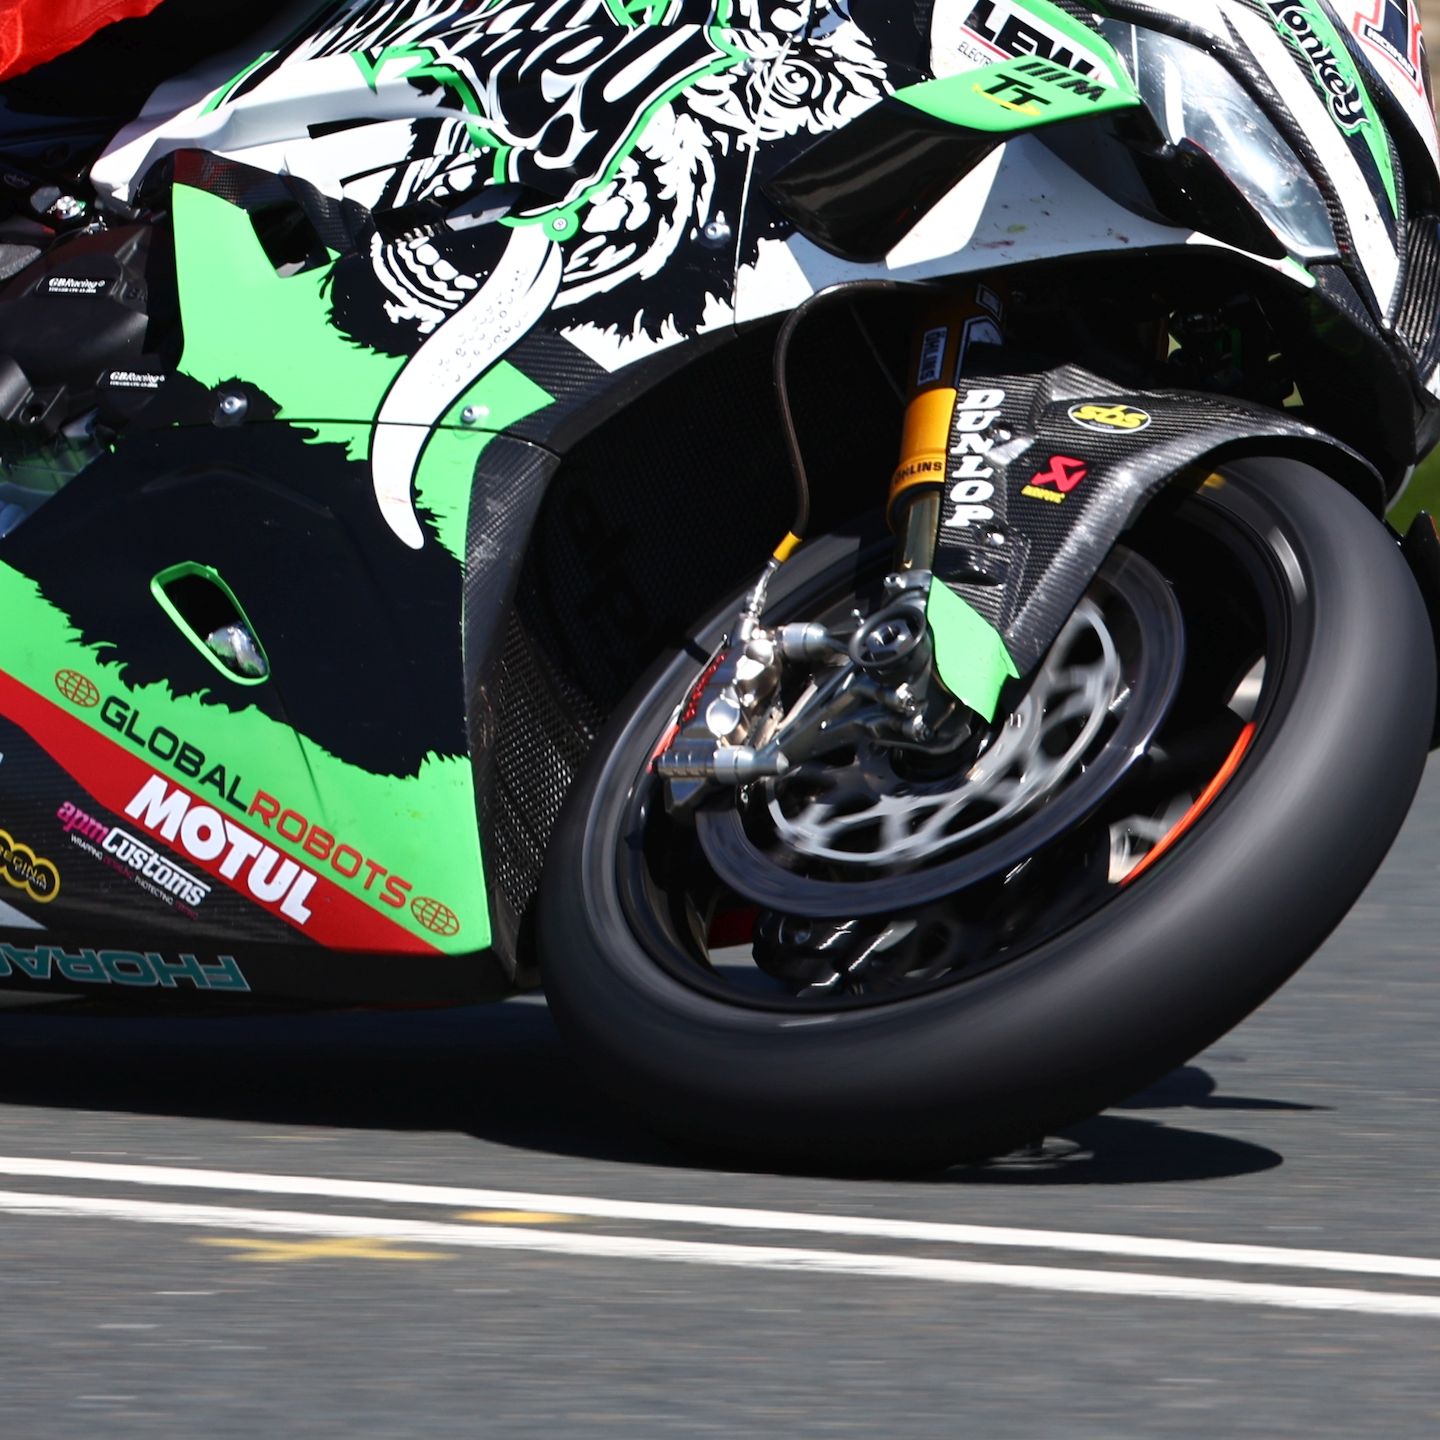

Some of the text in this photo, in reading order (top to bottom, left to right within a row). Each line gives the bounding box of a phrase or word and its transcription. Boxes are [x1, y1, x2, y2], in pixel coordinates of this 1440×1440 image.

[945, 388, 1006, 528] DUNLOP
[1071, 404, 1148, 429] sbs
[124, 773, 319, 925] MOTUL
